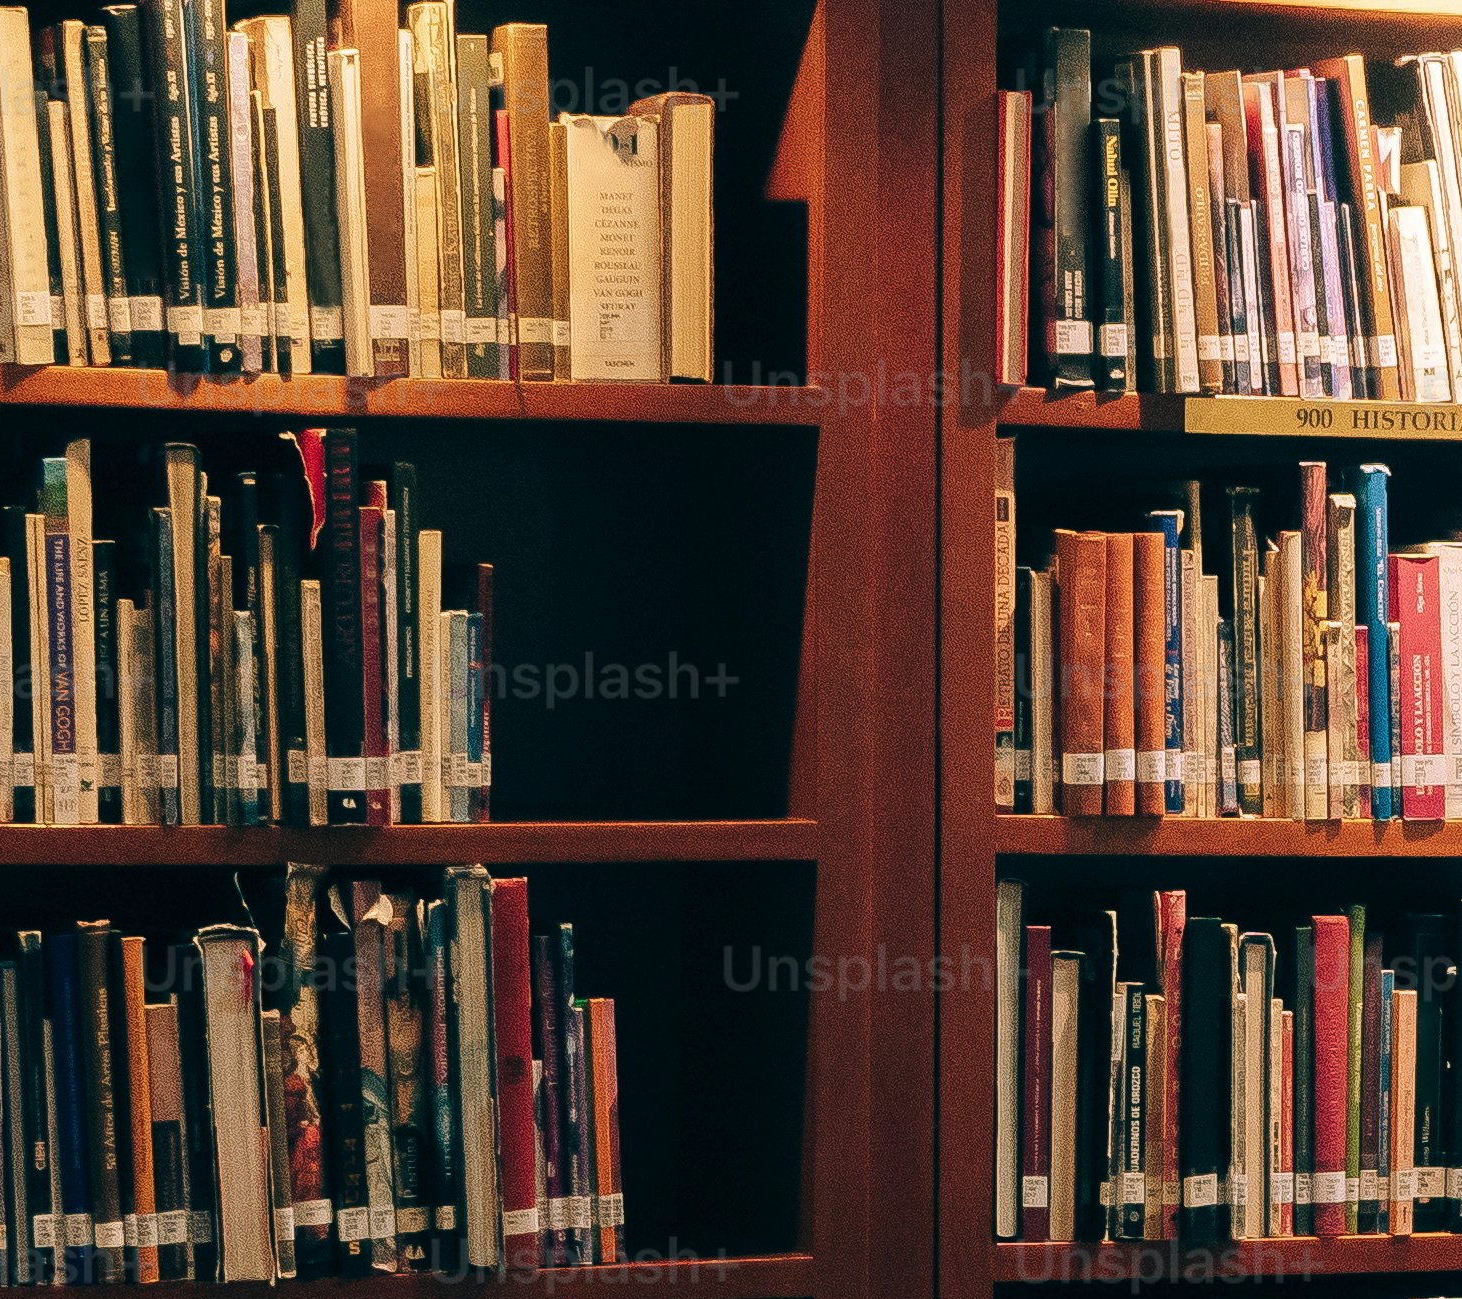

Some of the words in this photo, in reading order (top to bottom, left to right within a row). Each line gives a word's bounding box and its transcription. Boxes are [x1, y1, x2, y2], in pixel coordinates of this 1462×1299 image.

[1354, 99, 1371, 161] CARMEN
[177, 186, 190, 194] y
[1360, 163, 1378, 211] PARRA
[173, 196, 191, 241] México
[176, 242, 190, 257] de
[176, 258, 194, 300] Visión
[1296, 408, 1335, 431] 900
[53, 538, 64, 560] THE
[54, 585, 65, 609] AND
[55, 611, 66, 654] WORKS
[54, 671, 70, 701] VAN
[55, 705, 72, 751] GOGH
[1130, 1065, 1141, 1104] OROZCO
[1130, 1106, 1141, 1118] DE
[1130, 1120, 1141, 1172] UADERNOS
